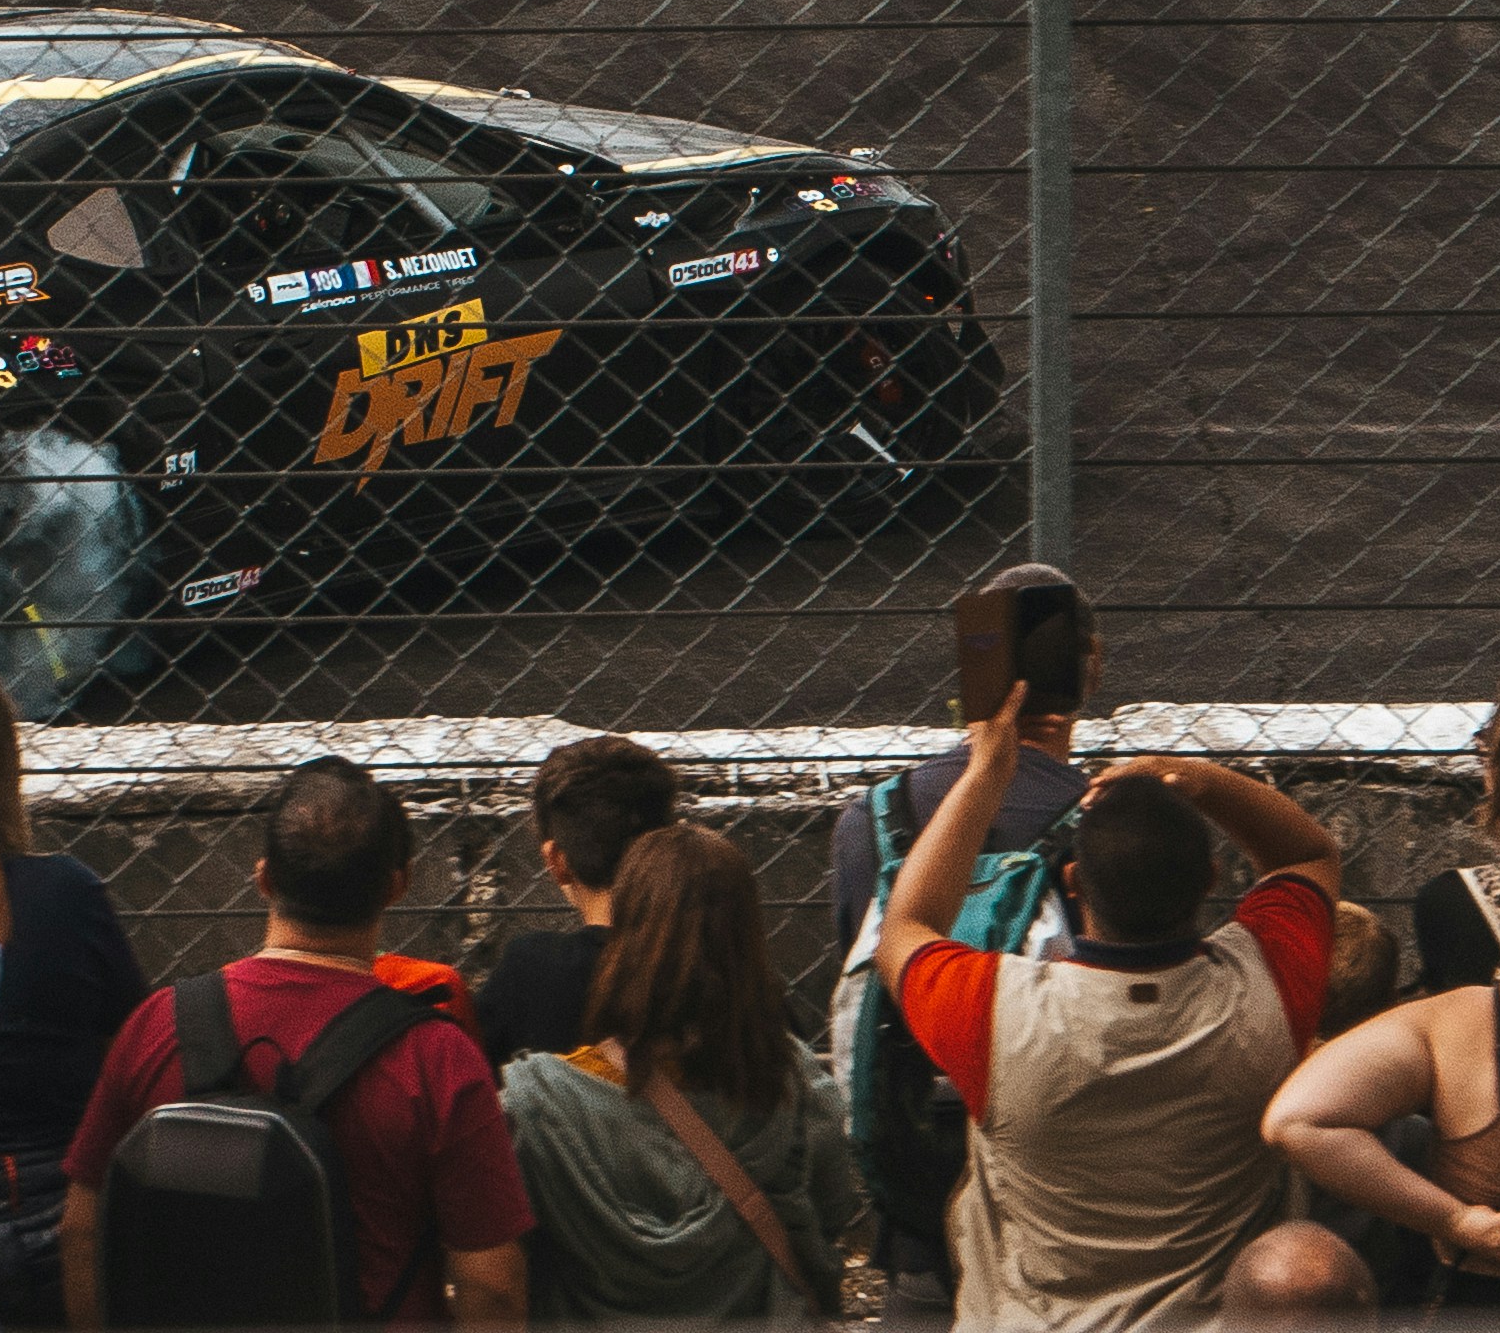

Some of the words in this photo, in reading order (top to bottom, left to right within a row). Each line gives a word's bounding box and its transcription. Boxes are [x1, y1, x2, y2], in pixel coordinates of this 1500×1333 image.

[311, 269, 343, 293] 100
[400, 247, 478, 278] NEZONDET
[735, 250, 760, 272] 41
[313, 329, 563, 497] DRIFT
